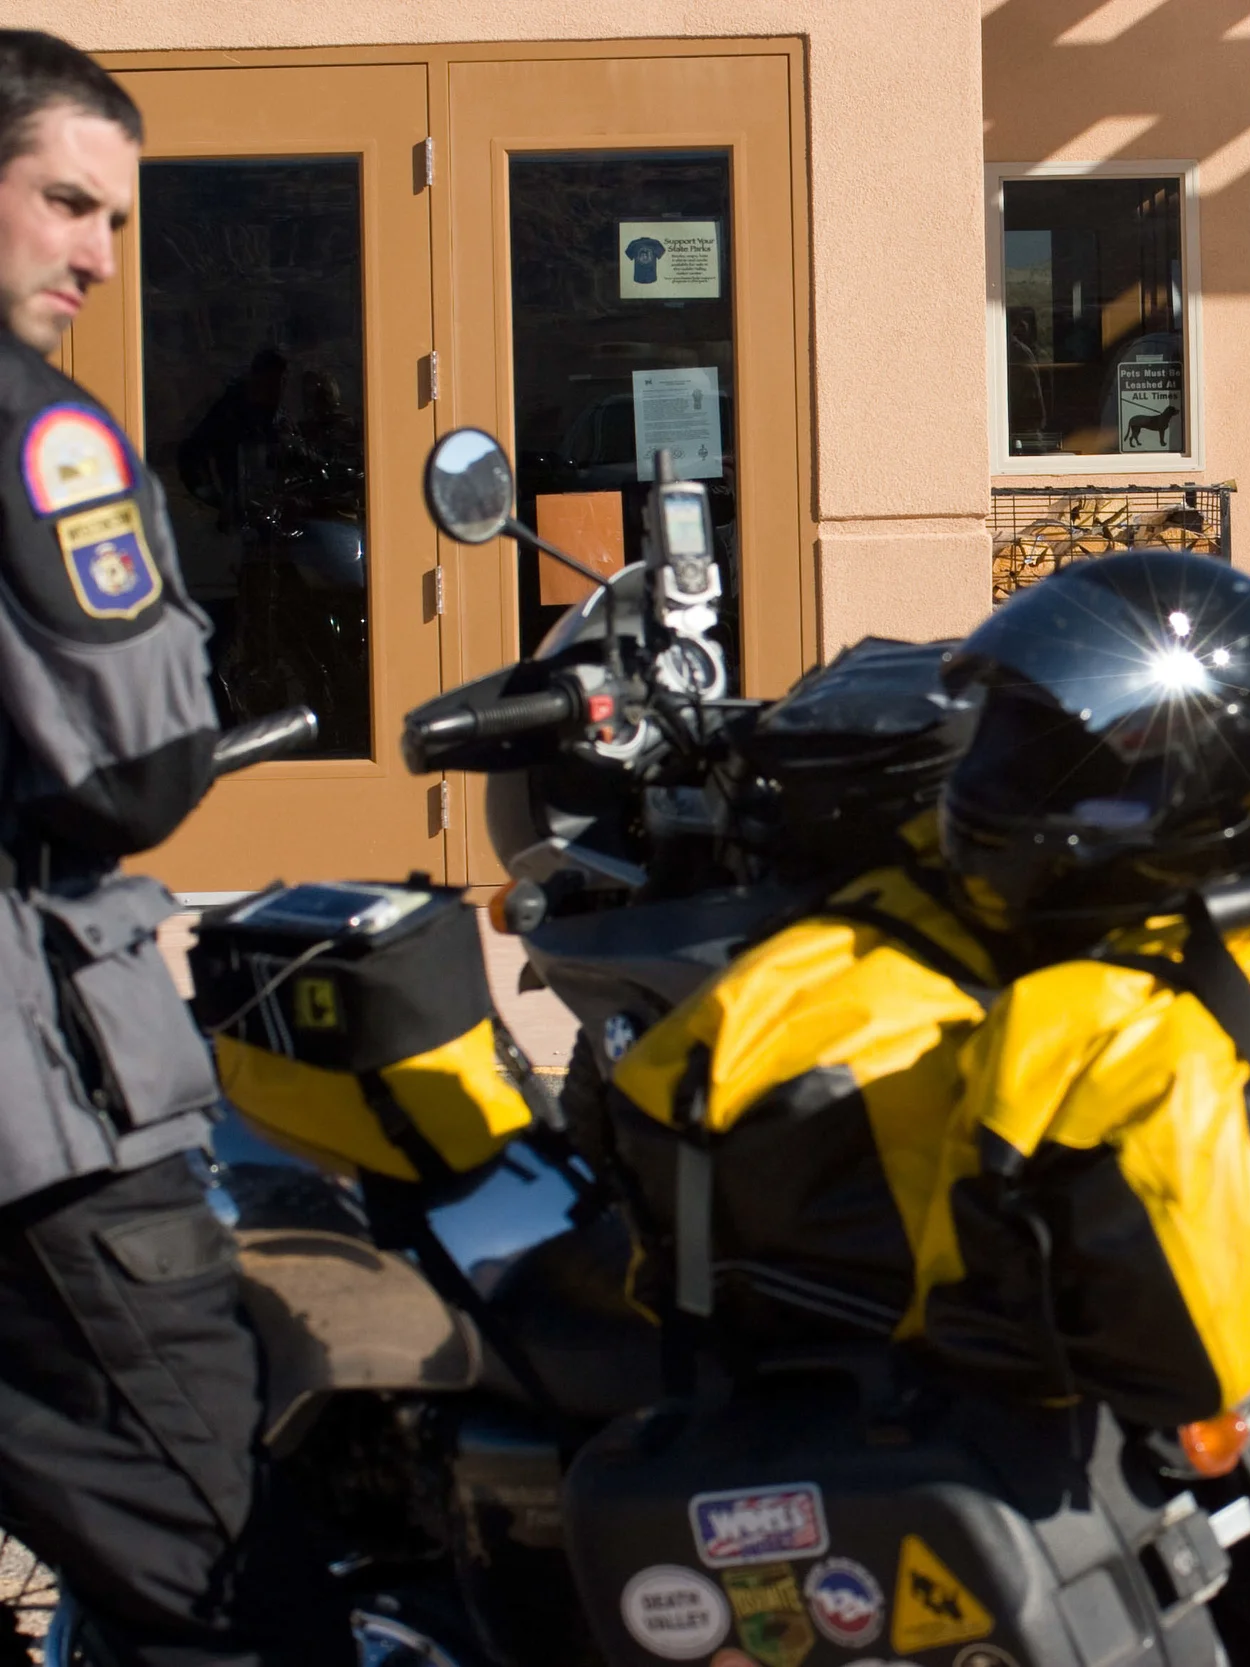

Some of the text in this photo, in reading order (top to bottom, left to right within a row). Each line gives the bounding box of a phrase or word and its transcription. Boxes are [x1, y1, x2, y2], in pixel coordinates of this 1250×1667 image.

[664, 238, 696, 247] Support
[690, 244, 711, 252] Parks
[1121, 369, 1180, 378] Pets Must Be
[1125, 381, 1177, 389] Leashed At
[1132, 392, 1178, 400] ALL Times
[641, 1588, 701, 1610] DEATH
[643, 1610, 710, 1632] VALLEY
